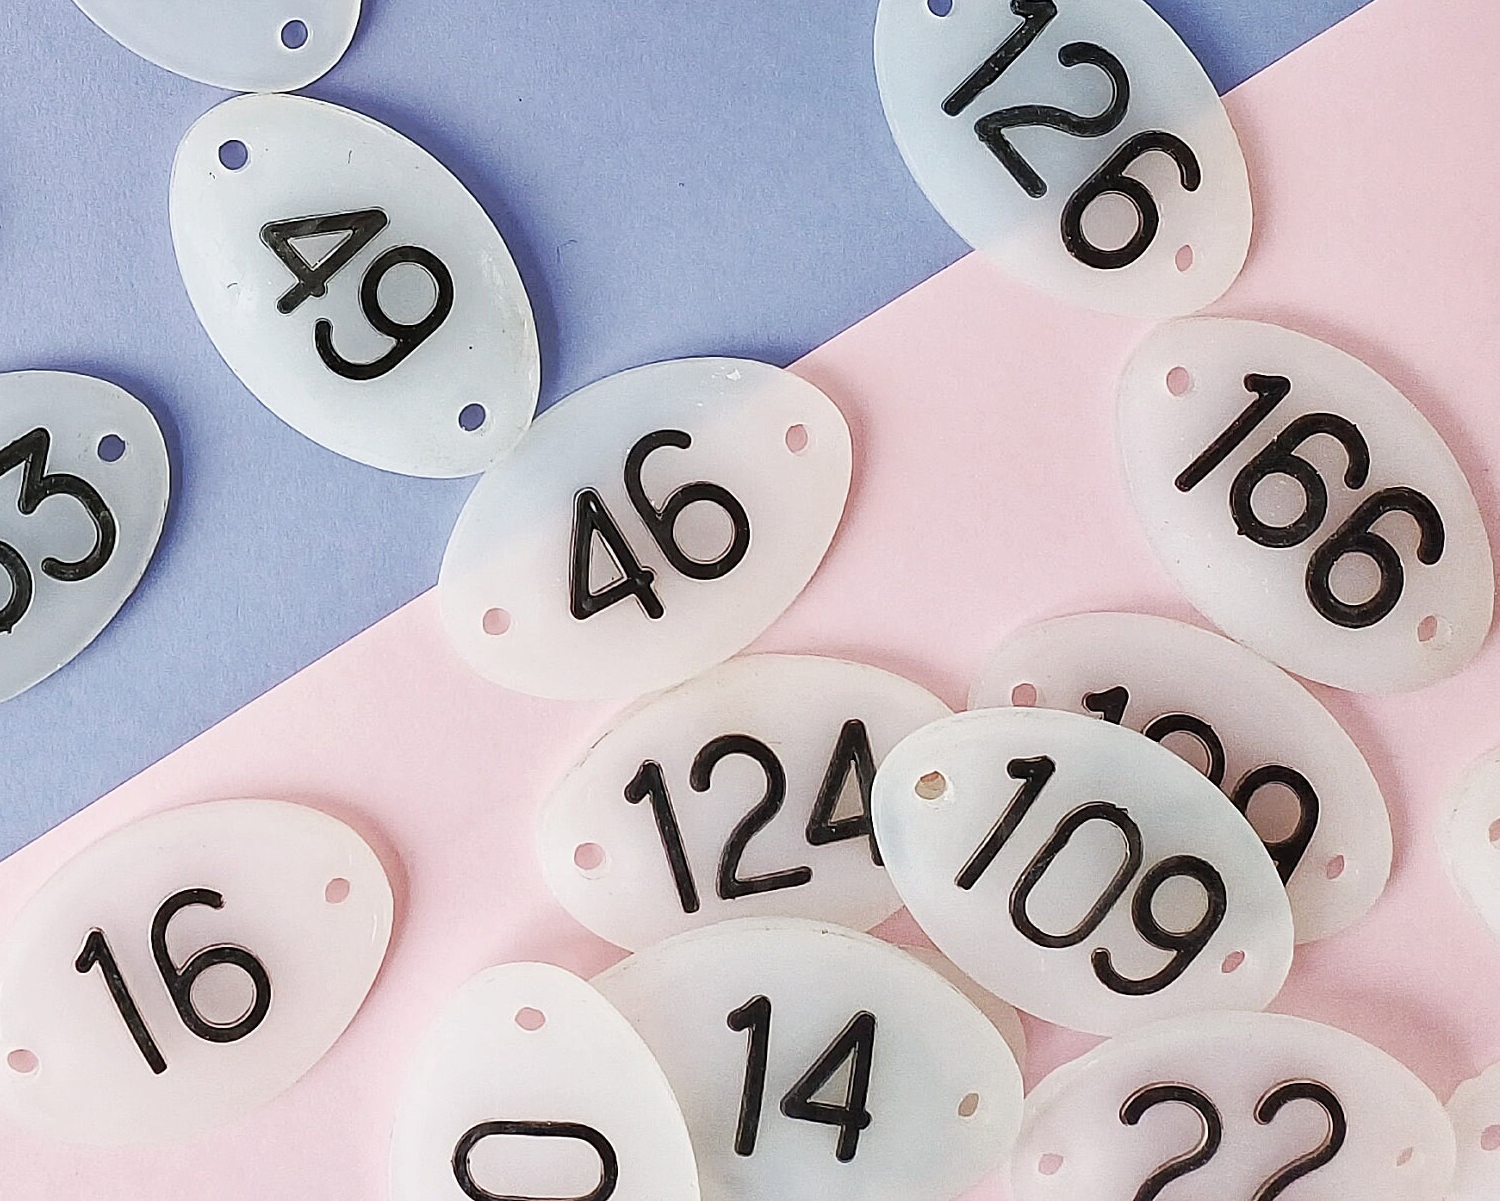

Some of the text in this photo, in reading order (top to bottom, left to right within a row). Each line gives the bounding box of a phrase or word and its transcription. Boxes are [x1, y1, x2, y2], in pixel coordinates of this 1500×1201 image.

[261, 209, 454, 381] 49
[570, 429, 750, 621] 46
[1175, 374, 1445, 630] 166
[623, 719, 885, 914] 124
[955, 755, 1228, 996] 109
[74, 889, 272, 1075] 16
[727, 995, 876, 1163] 14
[1119, 1080, 1347, 1201] 22
